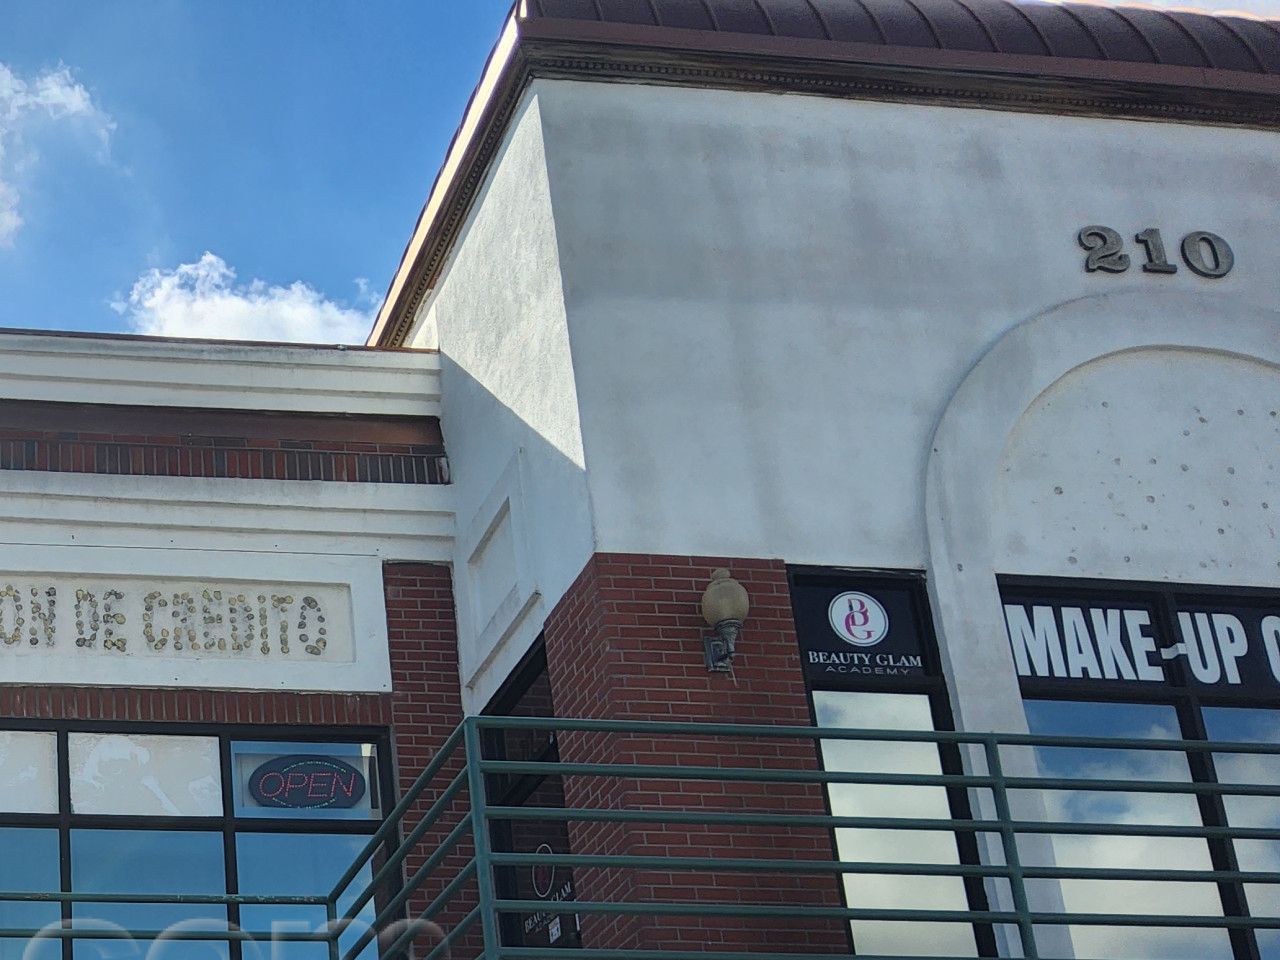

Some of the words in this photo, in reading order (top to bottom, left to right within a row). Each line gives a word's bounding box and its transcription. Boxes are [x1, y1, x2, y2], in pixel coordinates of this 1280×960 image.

[1077, 225, 1235, 279] 210
[1004, 604, 1249, 685] MAKE-UP
[808, 650, 871, 665] BEAUTY
[875, 653, 923, 667] GLAM
[825, 665, 910, 676] ACADEMY
[259, 771, 356, 797] OPEN
